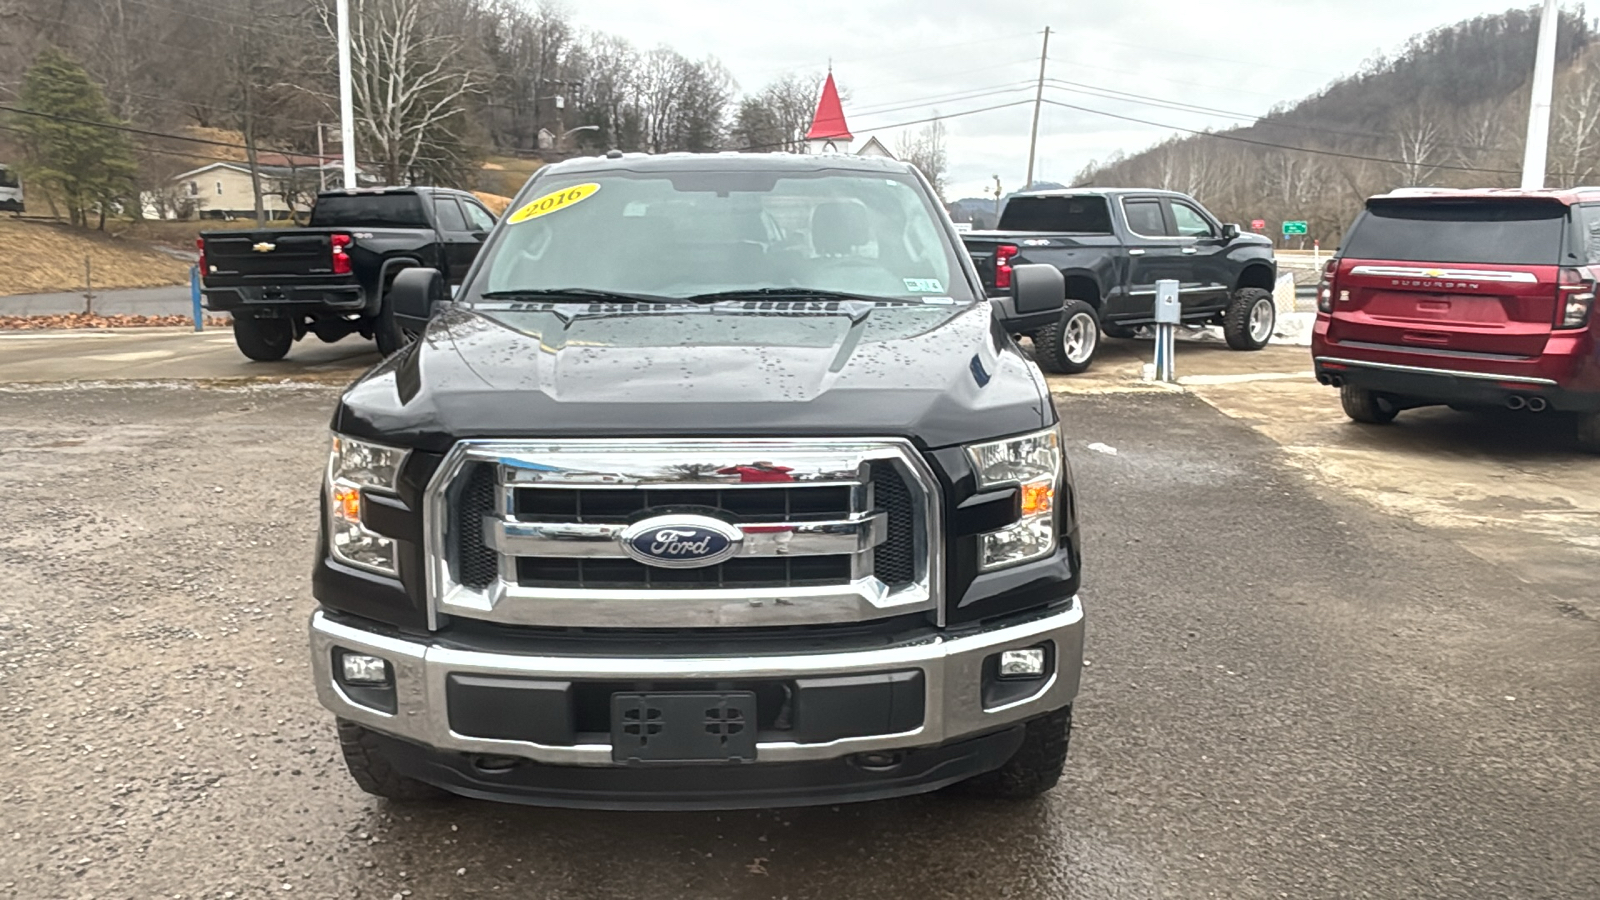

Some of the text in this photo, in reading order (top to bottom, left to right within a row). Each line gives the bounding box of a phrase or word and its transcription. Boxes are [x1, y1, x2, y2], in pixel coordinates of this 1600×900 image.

[524, 187, 582, 218] 2016
[1391, 279, 1479, 289] SUBURBAN
[651, 530, 711, 555] Ford
